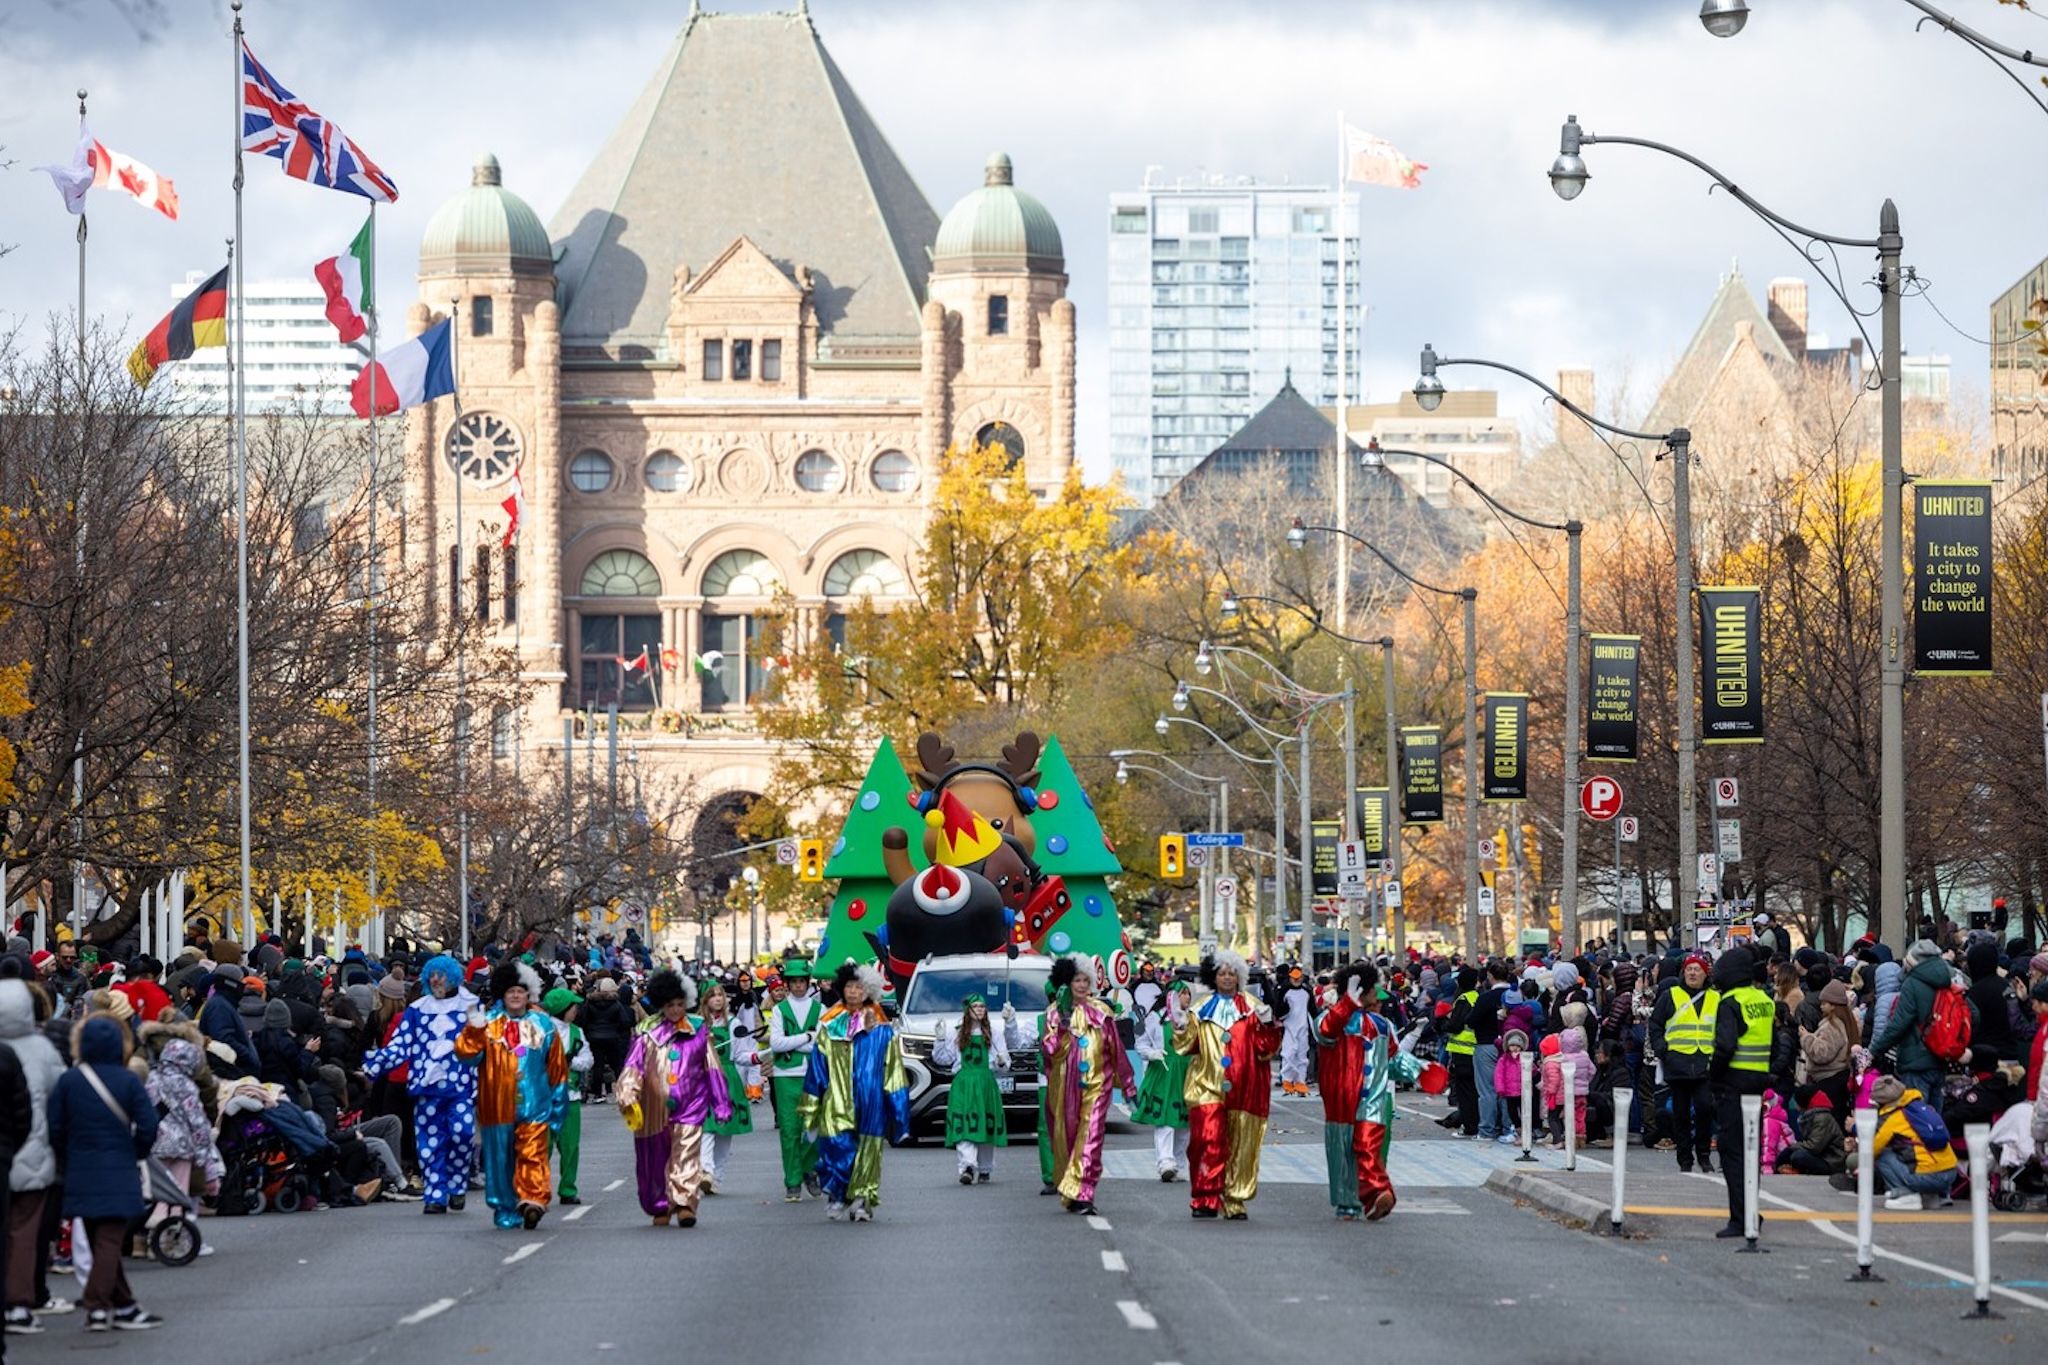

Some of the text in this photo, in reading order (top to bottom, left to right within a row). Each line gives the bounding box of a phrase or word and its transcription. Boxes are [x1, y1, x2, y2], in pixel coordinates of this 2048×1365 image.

[1923, 496, 1985, 517] UHNITED
[1928, 542, 1979, 557] It takes
[1926, 560, 1981, 579] a city to
[1929, 578, 1978, 597] change
[1921, 596, 1985, 612] the world
[1594, 646, 1635, 660] UHNITED
[1715, 606, 1748, 708] UHNITED
[1935, 649, 1957, 660] UHN
[1597, 674, 1630, 686] It takes
[1595, 687, 1632, 699] a city to
[1597, 699, 1629, 711] change
[1591, 711, 1633, 721] the world
[1494, 706, 1518, 778] UHNITED
[1591, 781, 1615, 809] P
[1196, 834, 1228, 846] College
